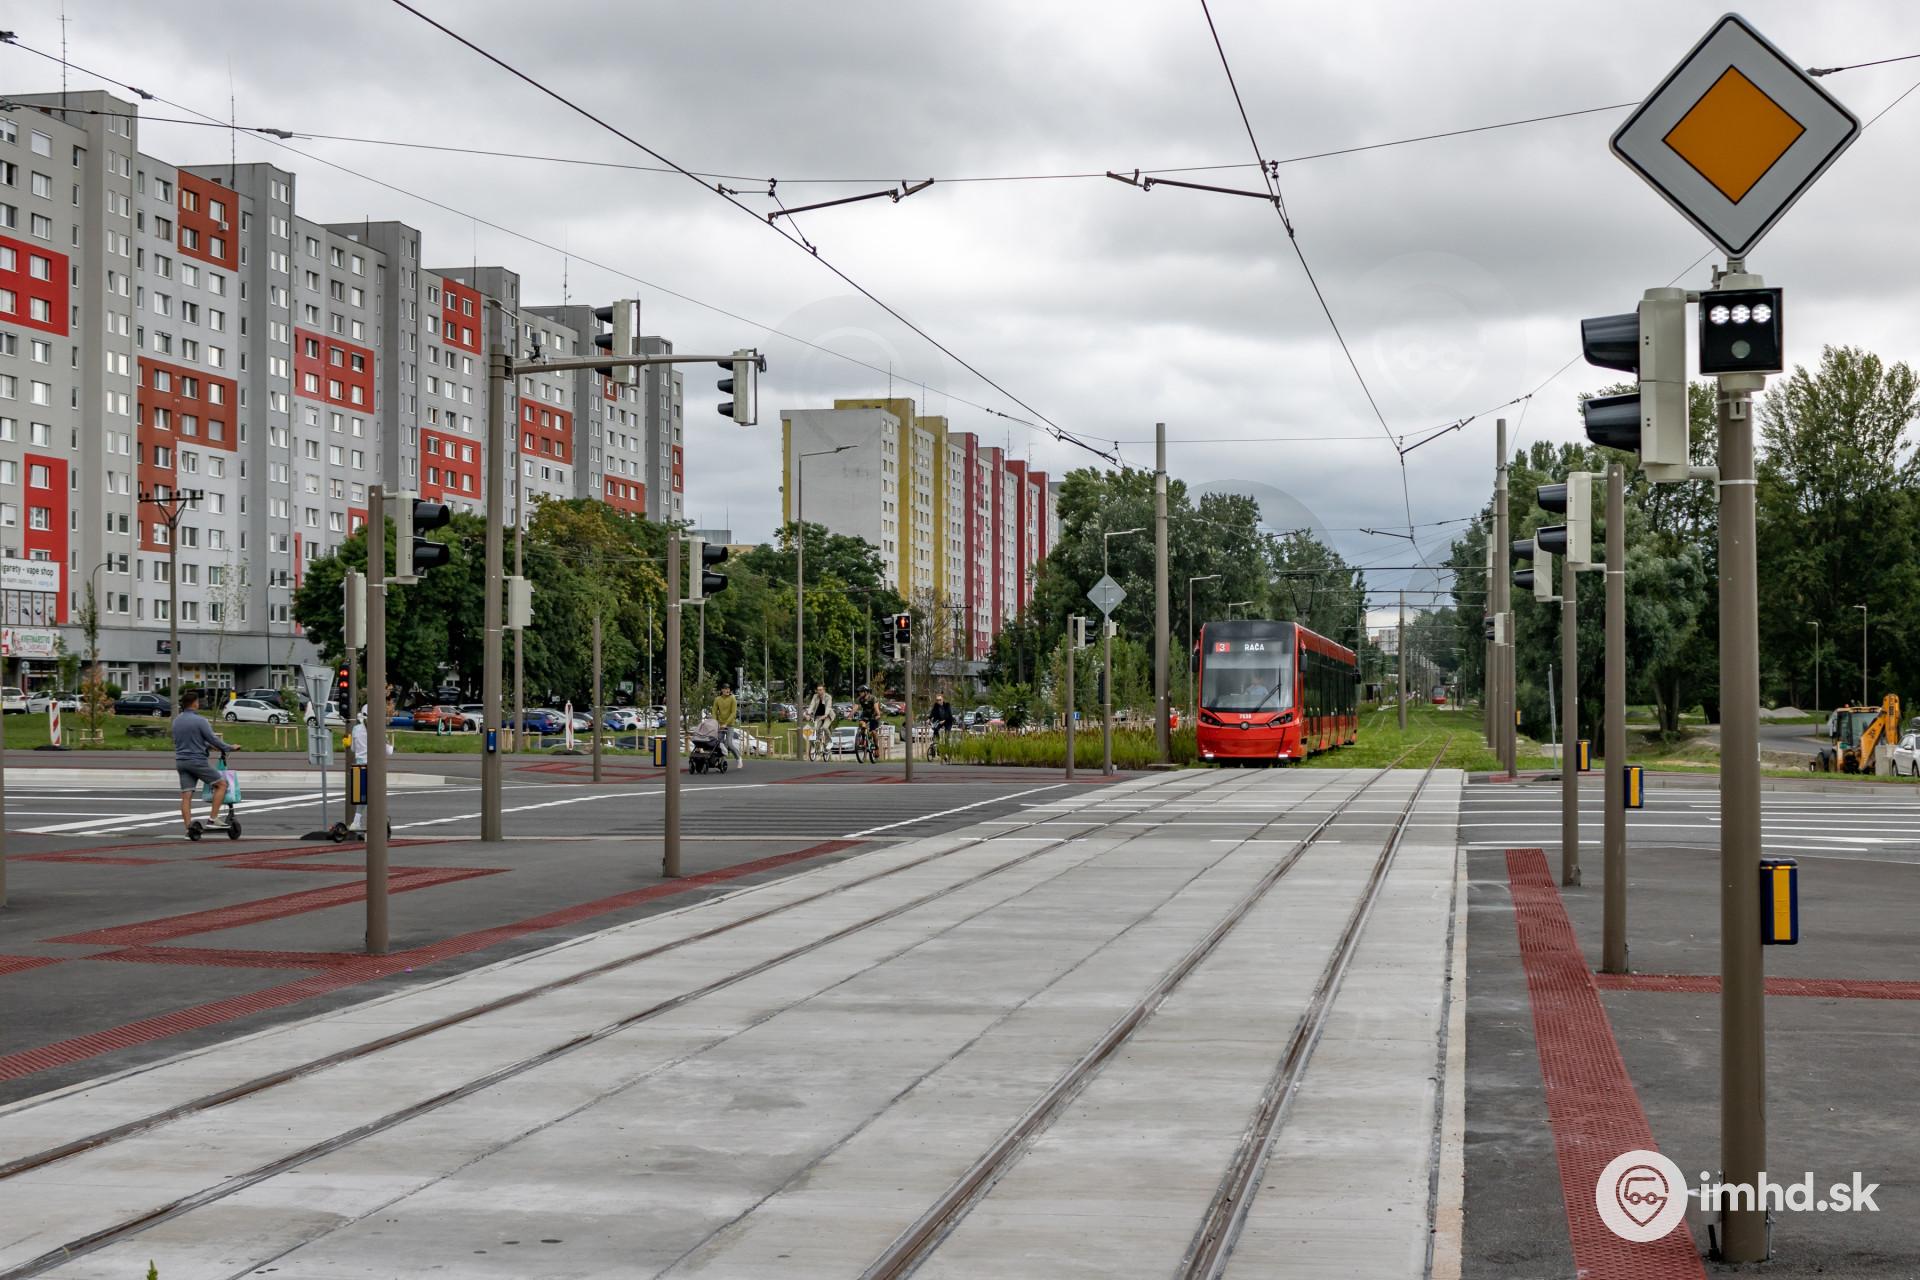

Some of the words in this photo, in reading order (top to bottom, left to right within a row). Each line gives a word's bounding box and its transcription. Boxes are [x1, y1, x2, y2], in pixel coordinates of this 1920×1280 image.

[27, 566, 40, 577] vape
[41, 566, 54, 577] shop
[1244, 642, 1265, 652] RAČA
